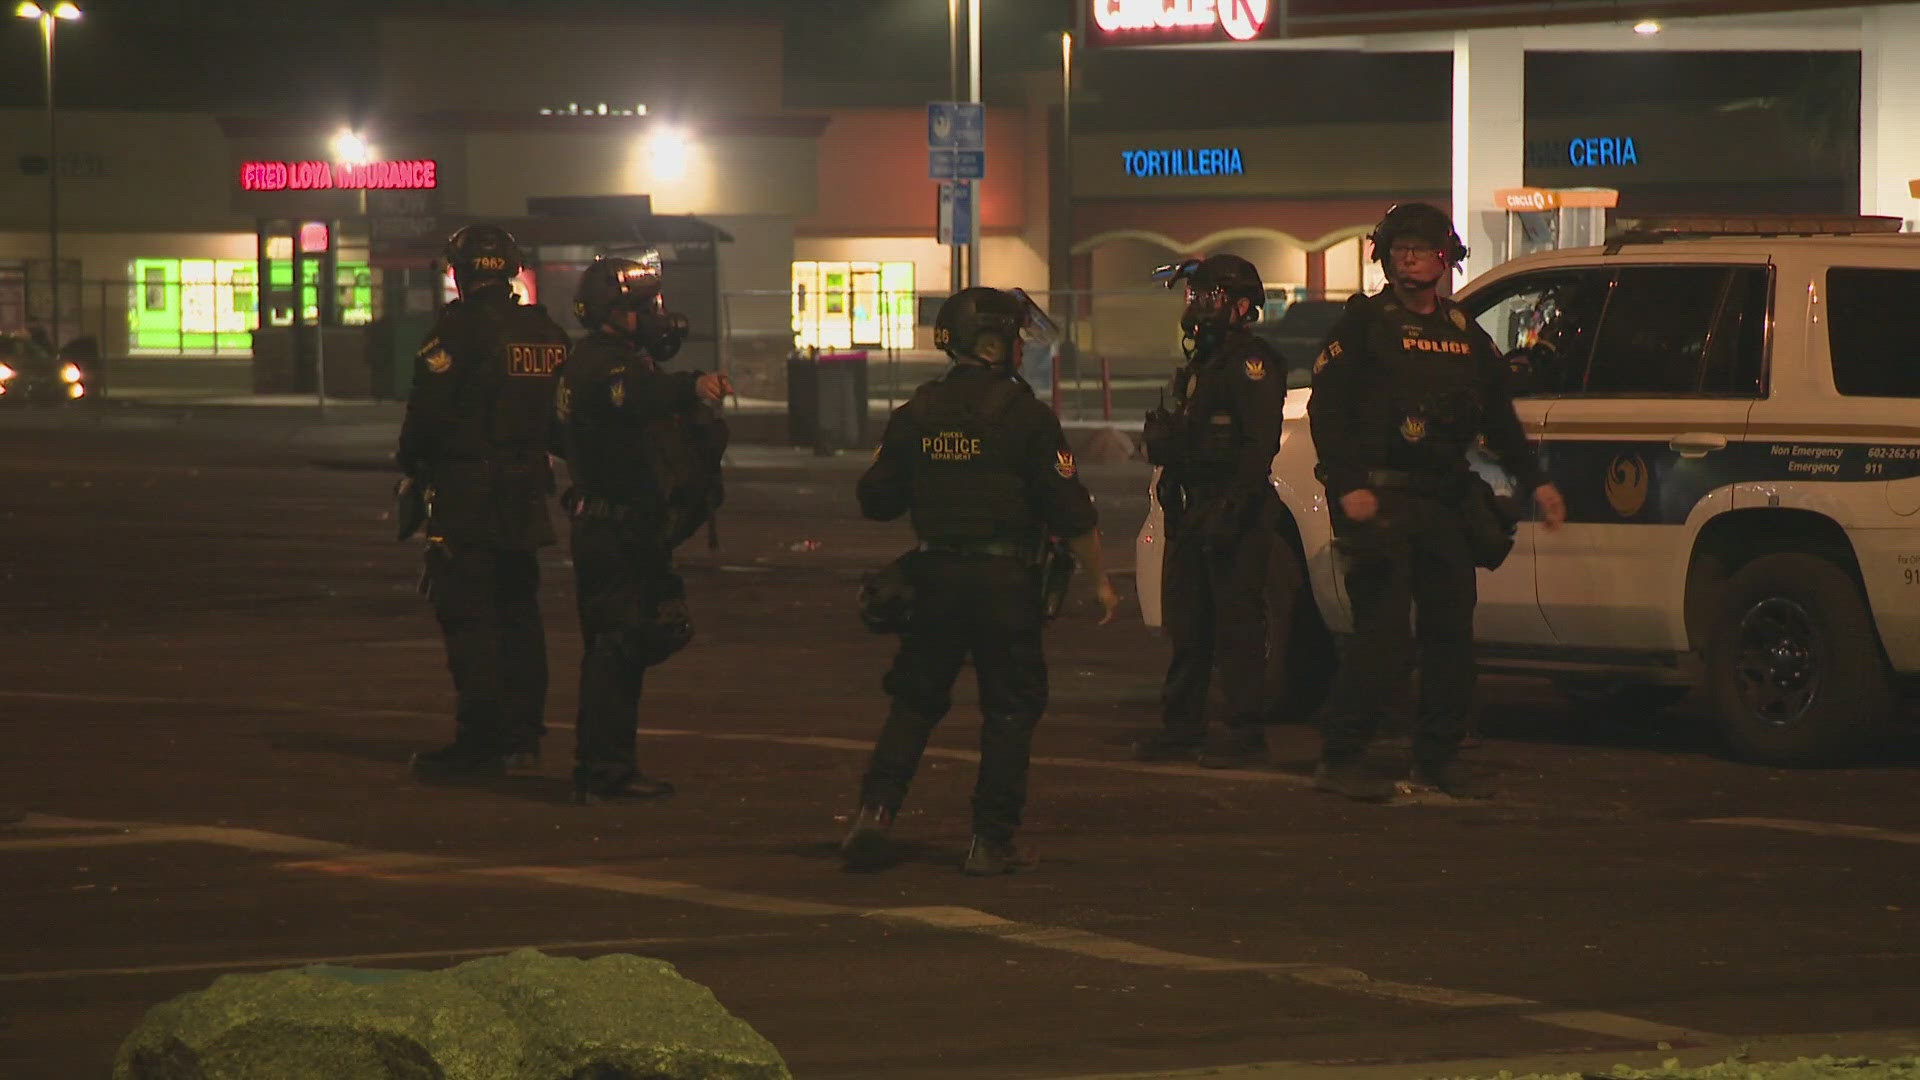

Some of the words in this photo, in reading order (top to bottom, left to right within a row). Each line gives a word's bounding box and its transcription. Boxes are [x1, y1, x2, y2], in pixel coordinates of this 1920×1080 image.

[1122, 148, 1244, 177] TORTILLERIA
[241, 161, 287, 190] FRED
[288, 161, 333, 190] LOYA
[334, 160, 437, 190] INSURANCE
[1402, 337, 1472, 355] POLICE
[922, 438, 981, 454] POLICE
[1770, 445, 1790, 456] Non
[1792, 445, 1843, 459] Emergency
[1788, 461, 1840, 475] Emergency
[1864, 463, 1883, 474] 911
